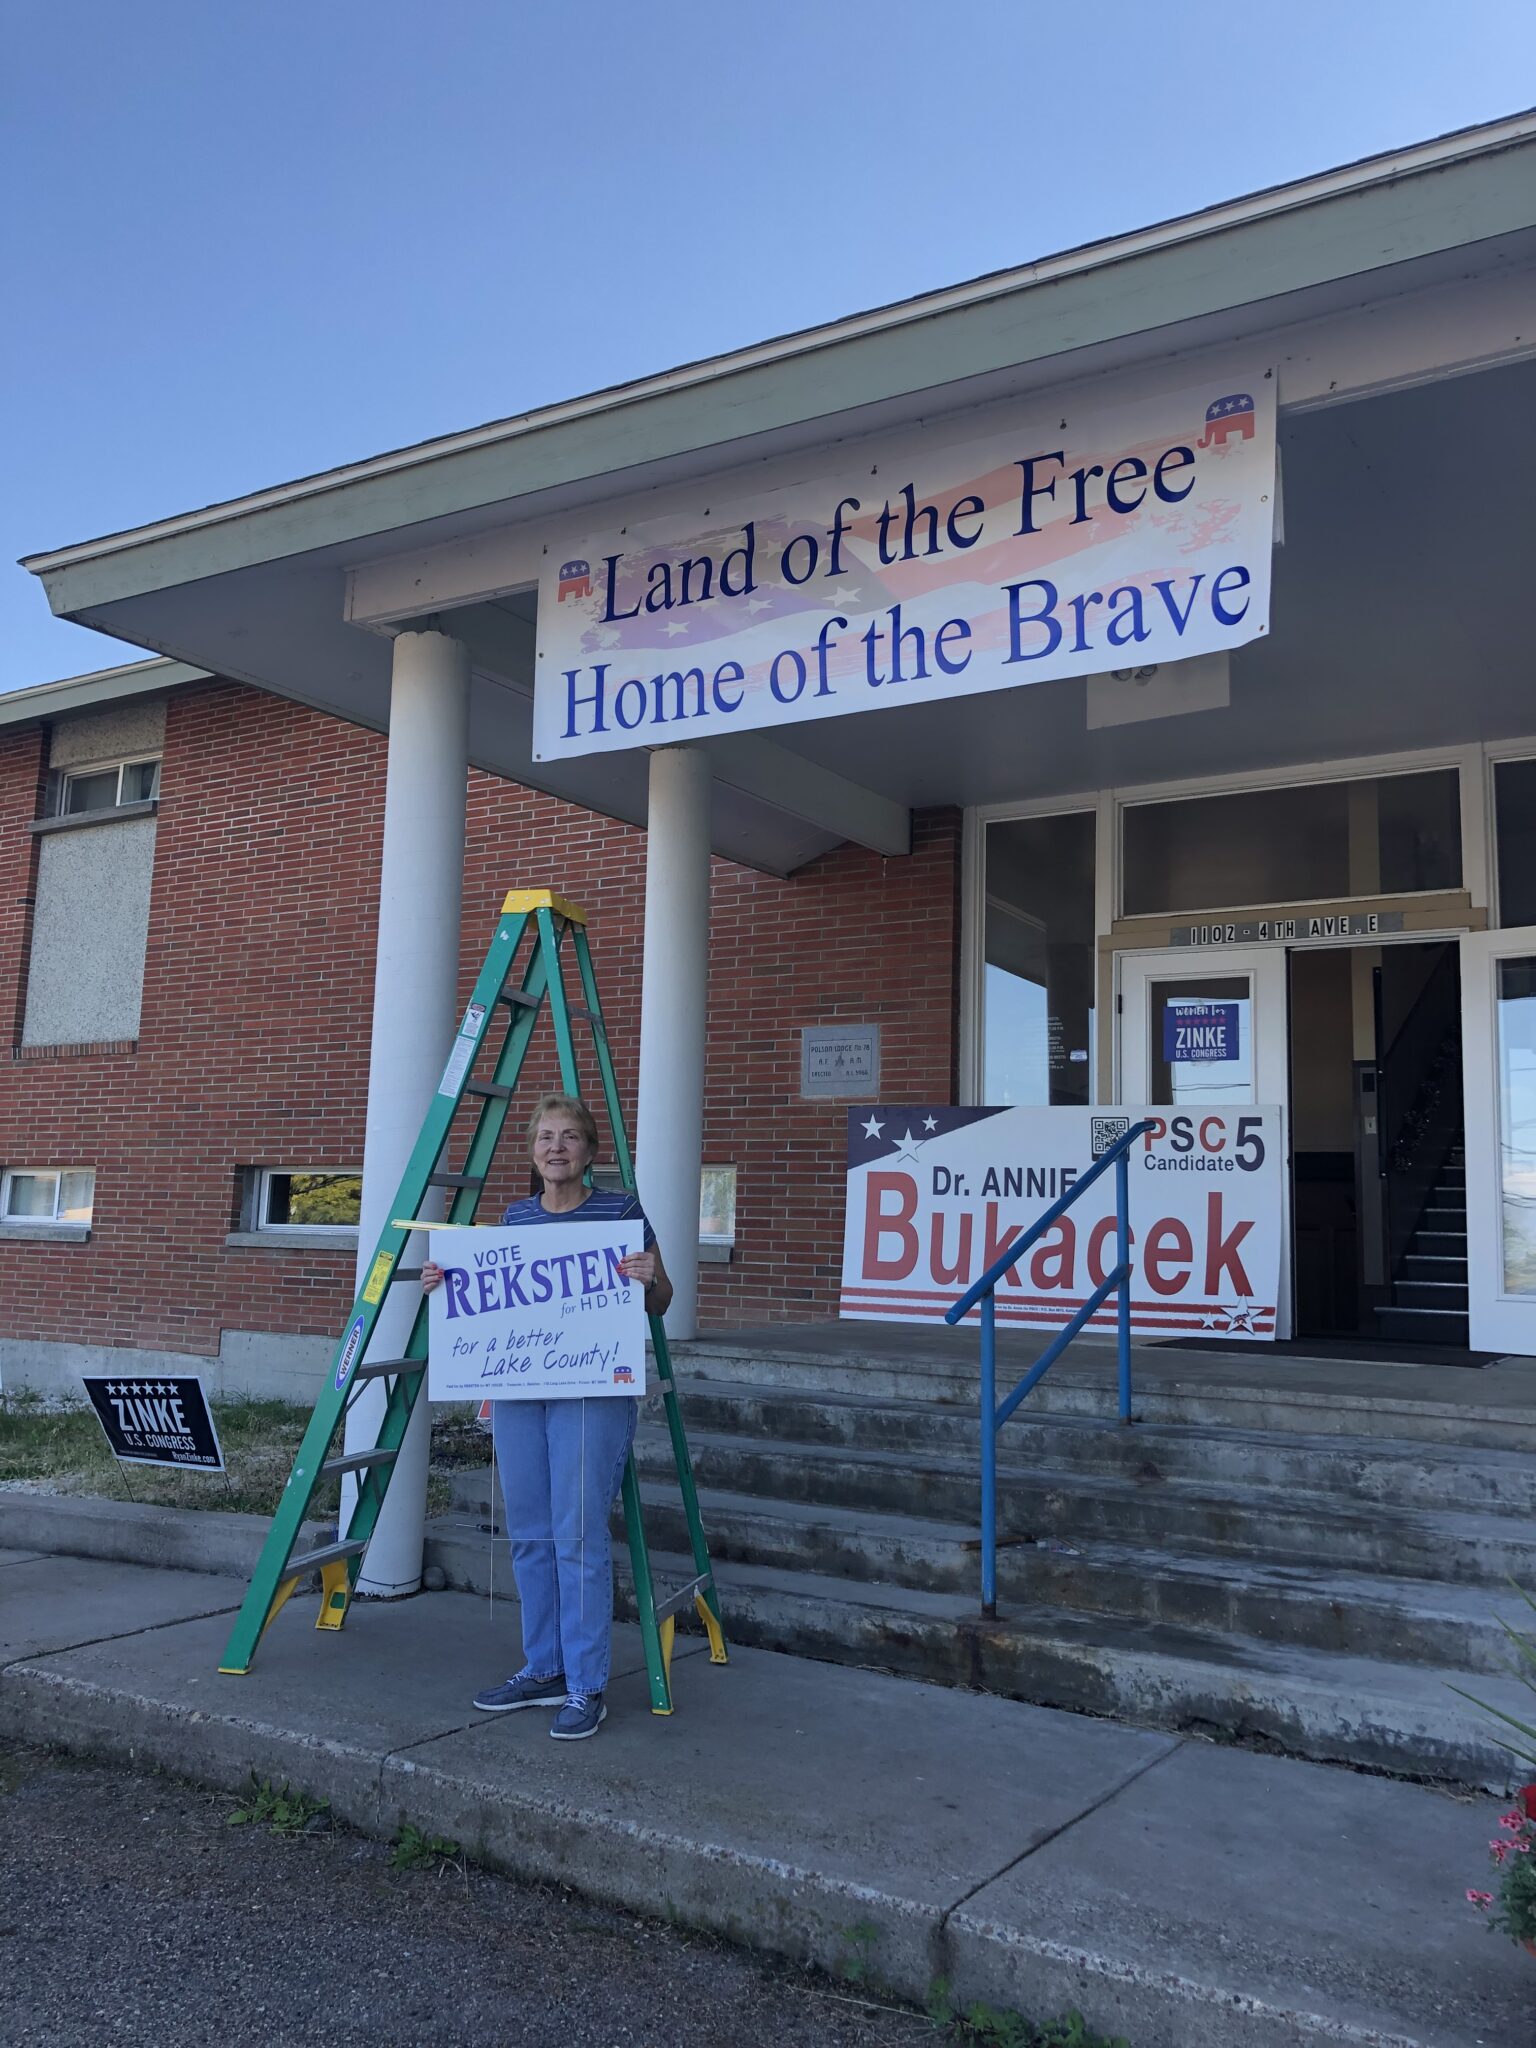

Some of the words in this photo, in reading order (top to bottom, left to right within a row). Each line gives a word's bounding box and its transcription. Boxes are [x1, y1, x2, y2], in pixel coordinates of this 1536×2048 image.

[599, 522, 757, 624] Land
[780, 498, 861, 585] of
[878, 483, 984, 566] the
[1012, 444, 1197, 537] Free
[560, 660, 745, 738] Home
[769, 616, 848, 704] of
[866, 603, 973, 689] the
[1002, 564, 1251, 665] Brave
[1192, 924, 1235, 944] 1102
[1369, 915, 1377, 932] E
[1175, 1026, 1227, 1049] ZINKE
[1175, 1050, 1189, 1059] U.S.
[1191, 1048, 1227, 1058] CONGRESS
[1144, 1116, 1226, 1152] PSC
[1235, 1117, 1265, 1171] 5
[1144, 1154, 1235, 1171] Candidate
[932, 1166, 970, 1196] Dr.
[861, 1171, 1256, 1298] Bukacek
[473, 1245, 522, 1268] VOTE
[444, 1244, 632, 1320] REKSTEN
[560, 1302, 577, 1319] for
[340, 1329, 360, 1375] WERNER
[452, 1337, 479, 1358] for
[486, 1336, 497, 1352] a
[507, 1328, 564, 1350] better
[480, 1352, 532, 1378] Lake
[543, 1341, 620, 1373] County!
[110, 1399, 191, 1434] ZINKE
[124, 1433, 146, 1447] U.S.
[146, 1434, 196, 1451] CONGRESS
[171, 1451, 216, 1464] RyanZinke.com
